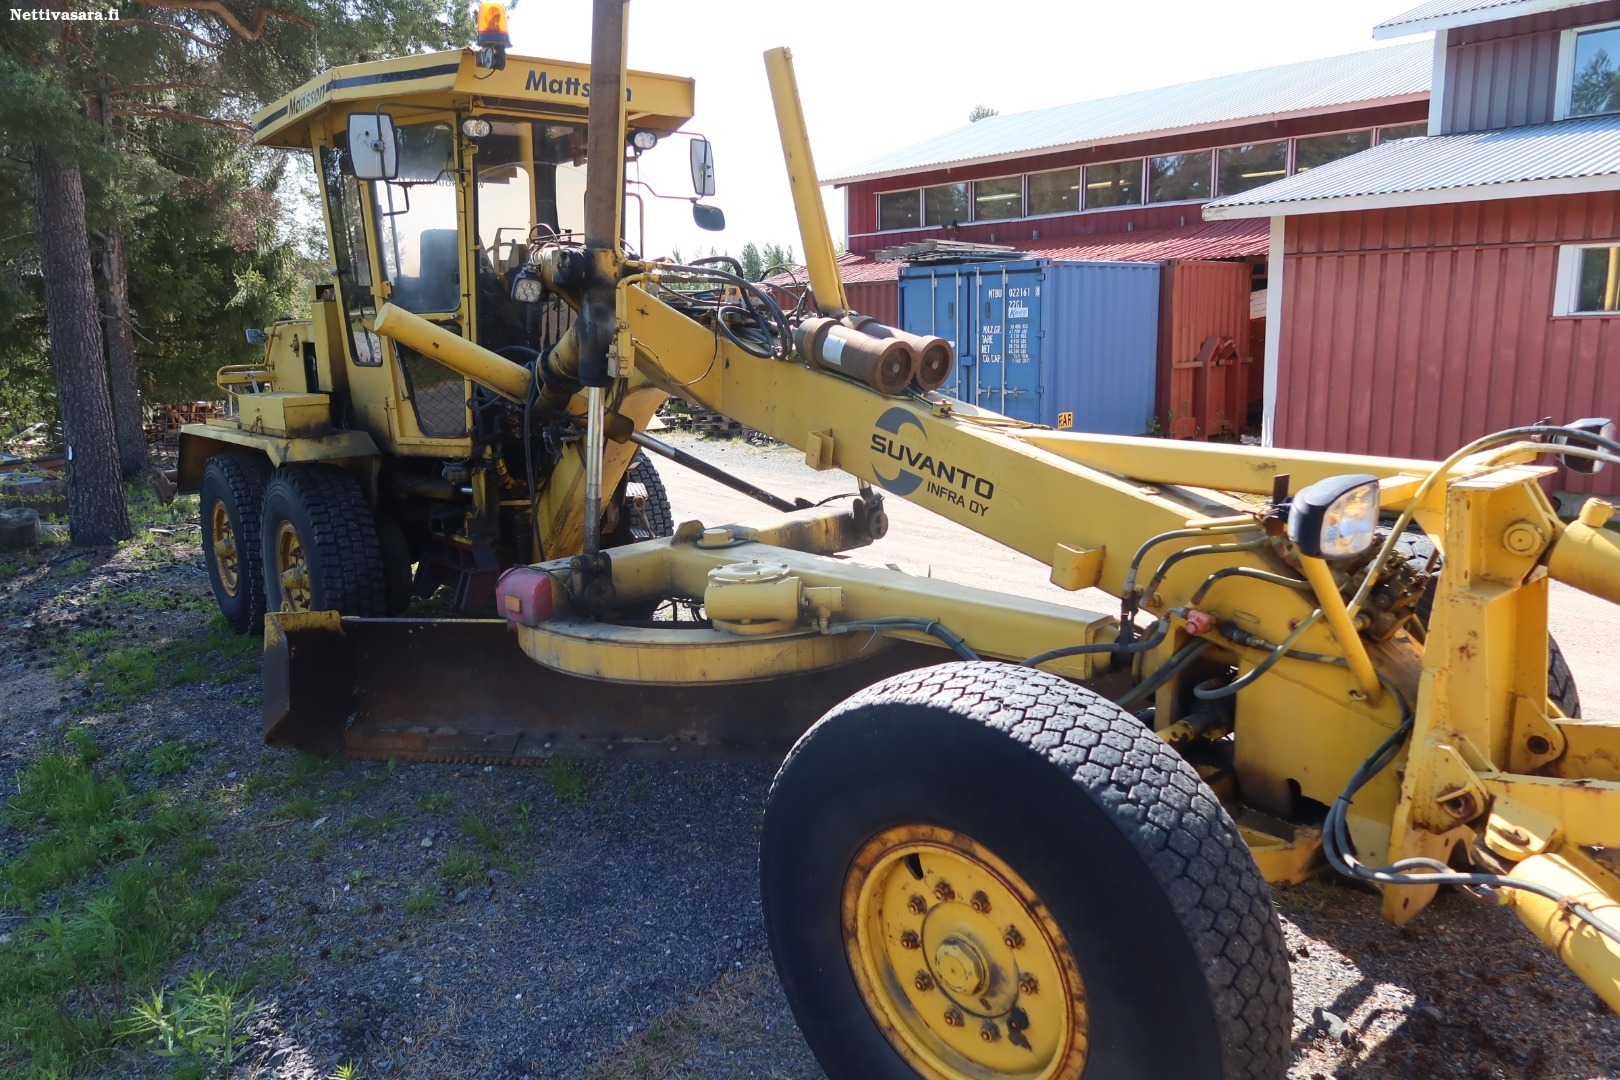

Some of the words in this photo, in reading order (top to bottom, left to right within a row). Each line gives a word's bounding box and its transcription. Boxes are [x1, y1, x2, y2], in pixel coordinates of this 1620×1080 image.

[989, 288, 1003, 299] MTBU
[1008, 287, 1030, 298] 022161
[981, 334, 993, 344] TARE
[981, 344, 990, 354] NET
[870, 433, 994, 500] SUVANTO
[927, 481, 965, 508] INFRA
[969, 499, 989, 517] OY
